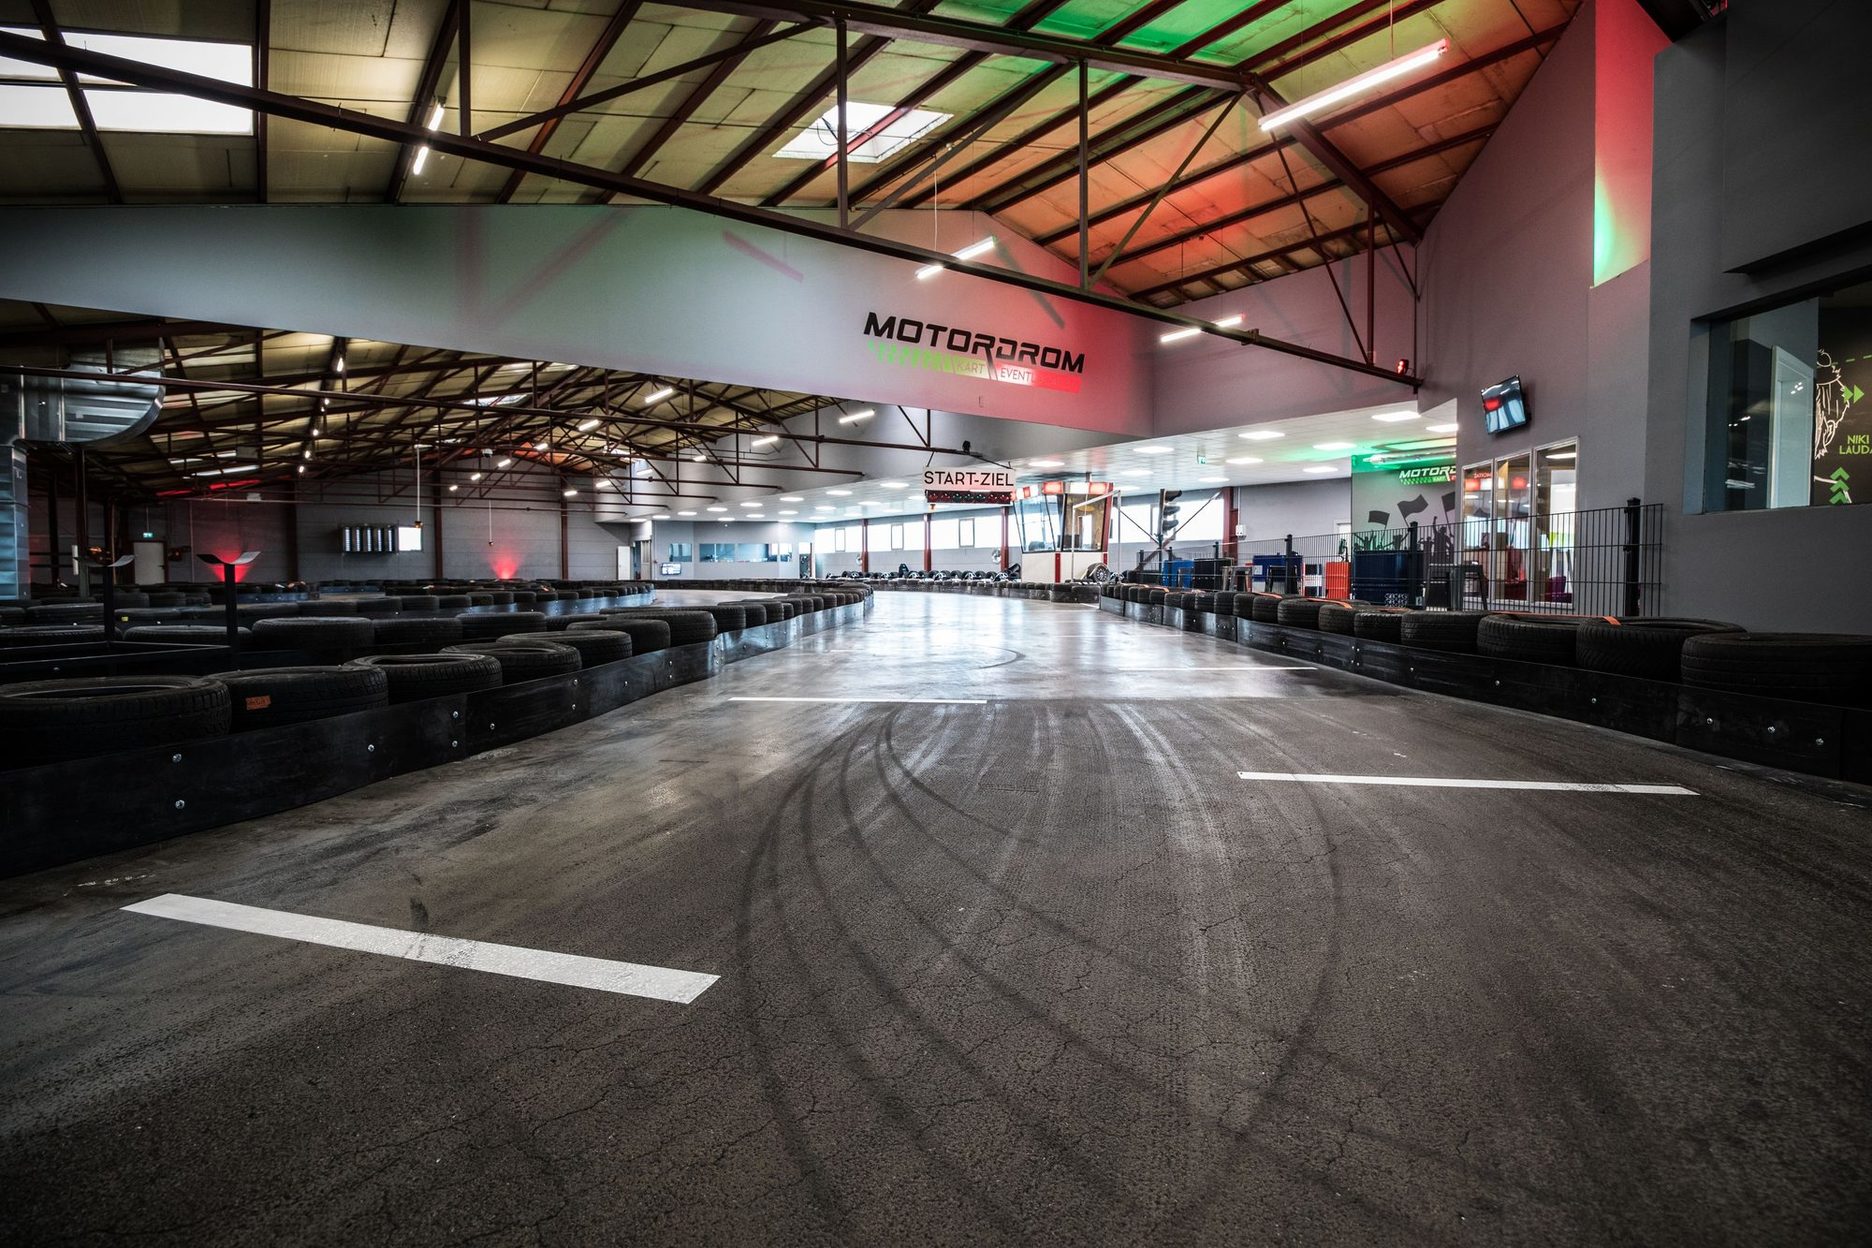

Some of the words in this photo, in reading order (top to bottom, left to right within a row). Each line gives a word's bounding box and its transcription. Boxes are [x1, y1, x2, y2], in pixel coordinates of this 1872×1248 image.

[864, 312, 1085, 376] MOTORDROM
[1847, 434, 1870, 445] NIKI
[924, 470, 1014, 487] START-ZIEL
